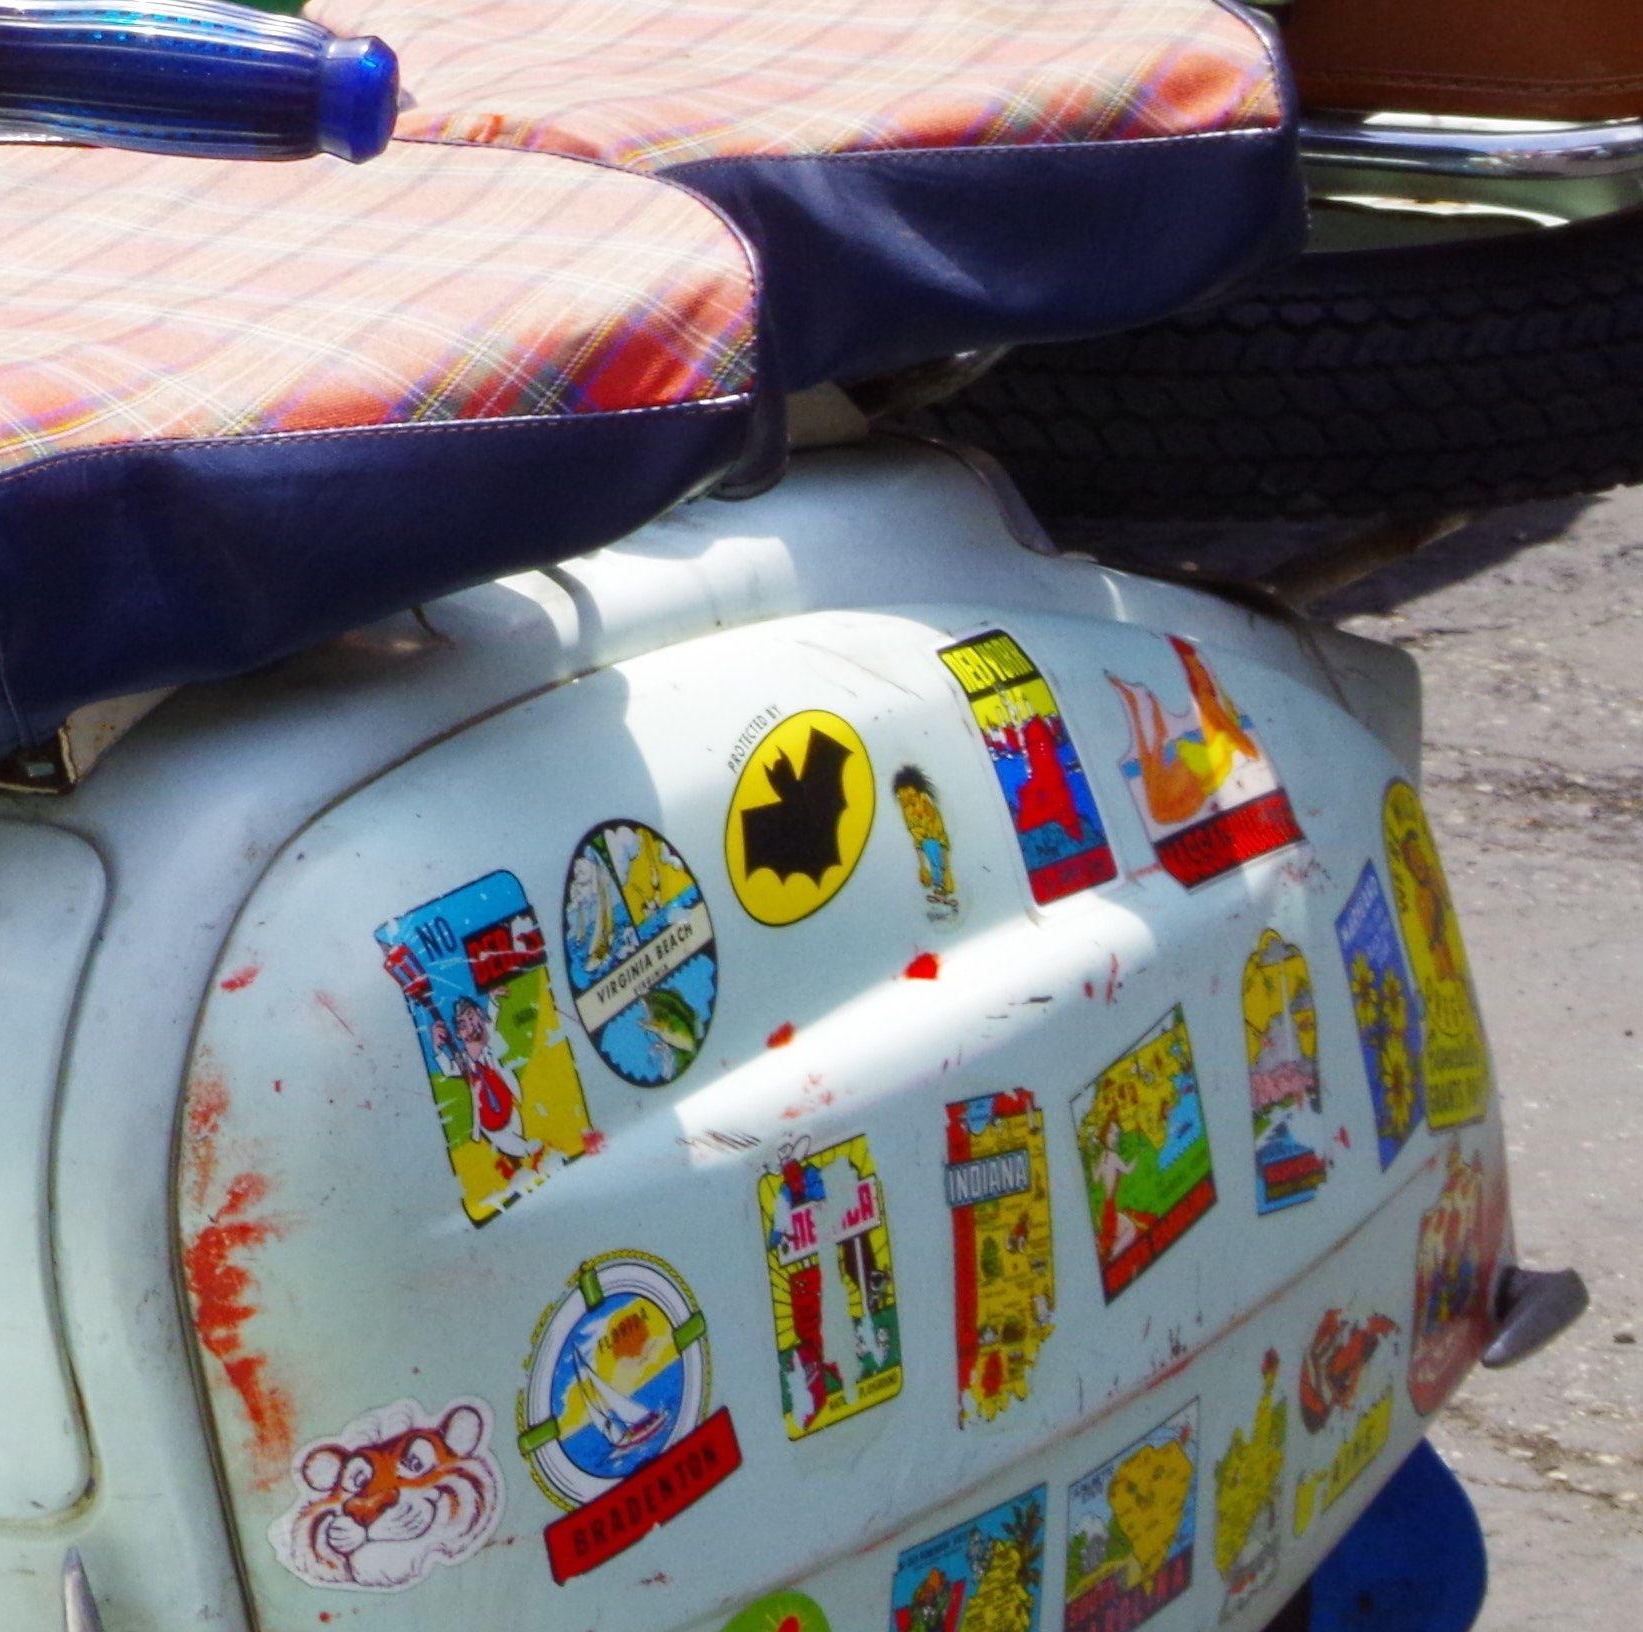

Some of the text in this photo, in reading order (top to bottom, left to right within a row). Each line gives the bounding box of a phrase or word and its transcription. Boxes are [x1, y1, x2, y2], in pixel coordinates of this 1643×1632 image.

[727, 703, 782, 774] PROTECTED BY
[415, 916, 458, 961] NO
[596, 953, 653, 1003] VIRGINIA
[655, 922, 693, 961] BEACH
[948, 1151, 1028, 1202] INDIANA
[573, 1441, 716, 1558] BRADENTON
